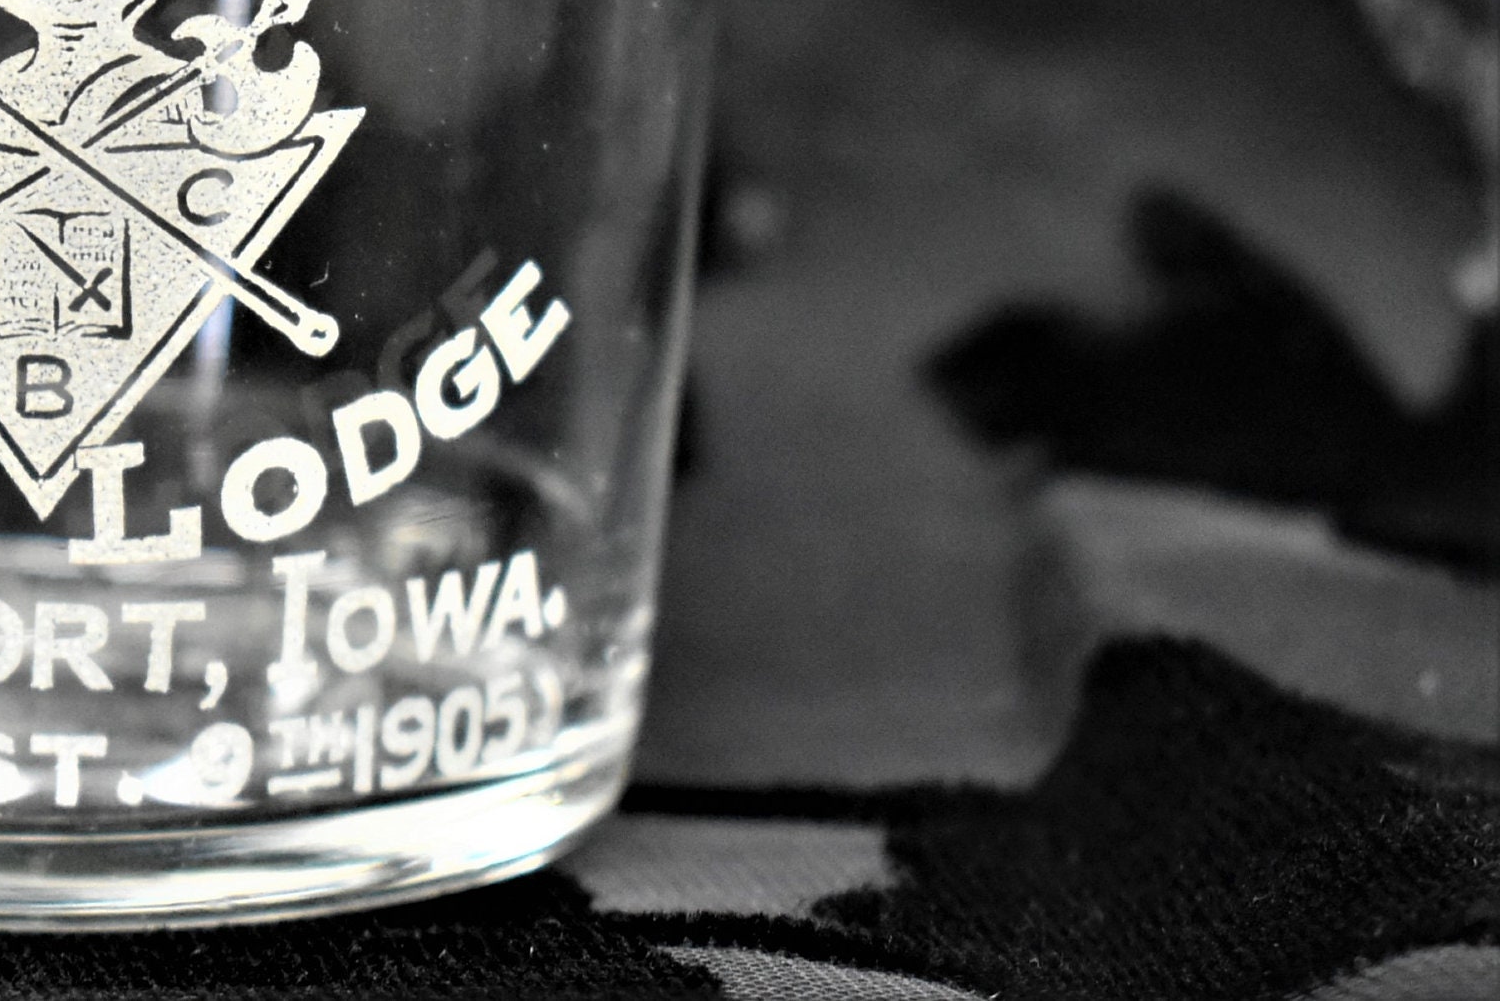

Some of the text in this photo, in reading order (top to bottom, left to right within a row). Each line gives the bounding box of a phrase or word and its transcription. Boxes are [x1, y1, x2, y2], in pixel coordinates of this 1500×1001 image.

[176, 168, 234, 227] C
[15, 355, 74, 420] B
[68, 259, 572, 566] LODGE
